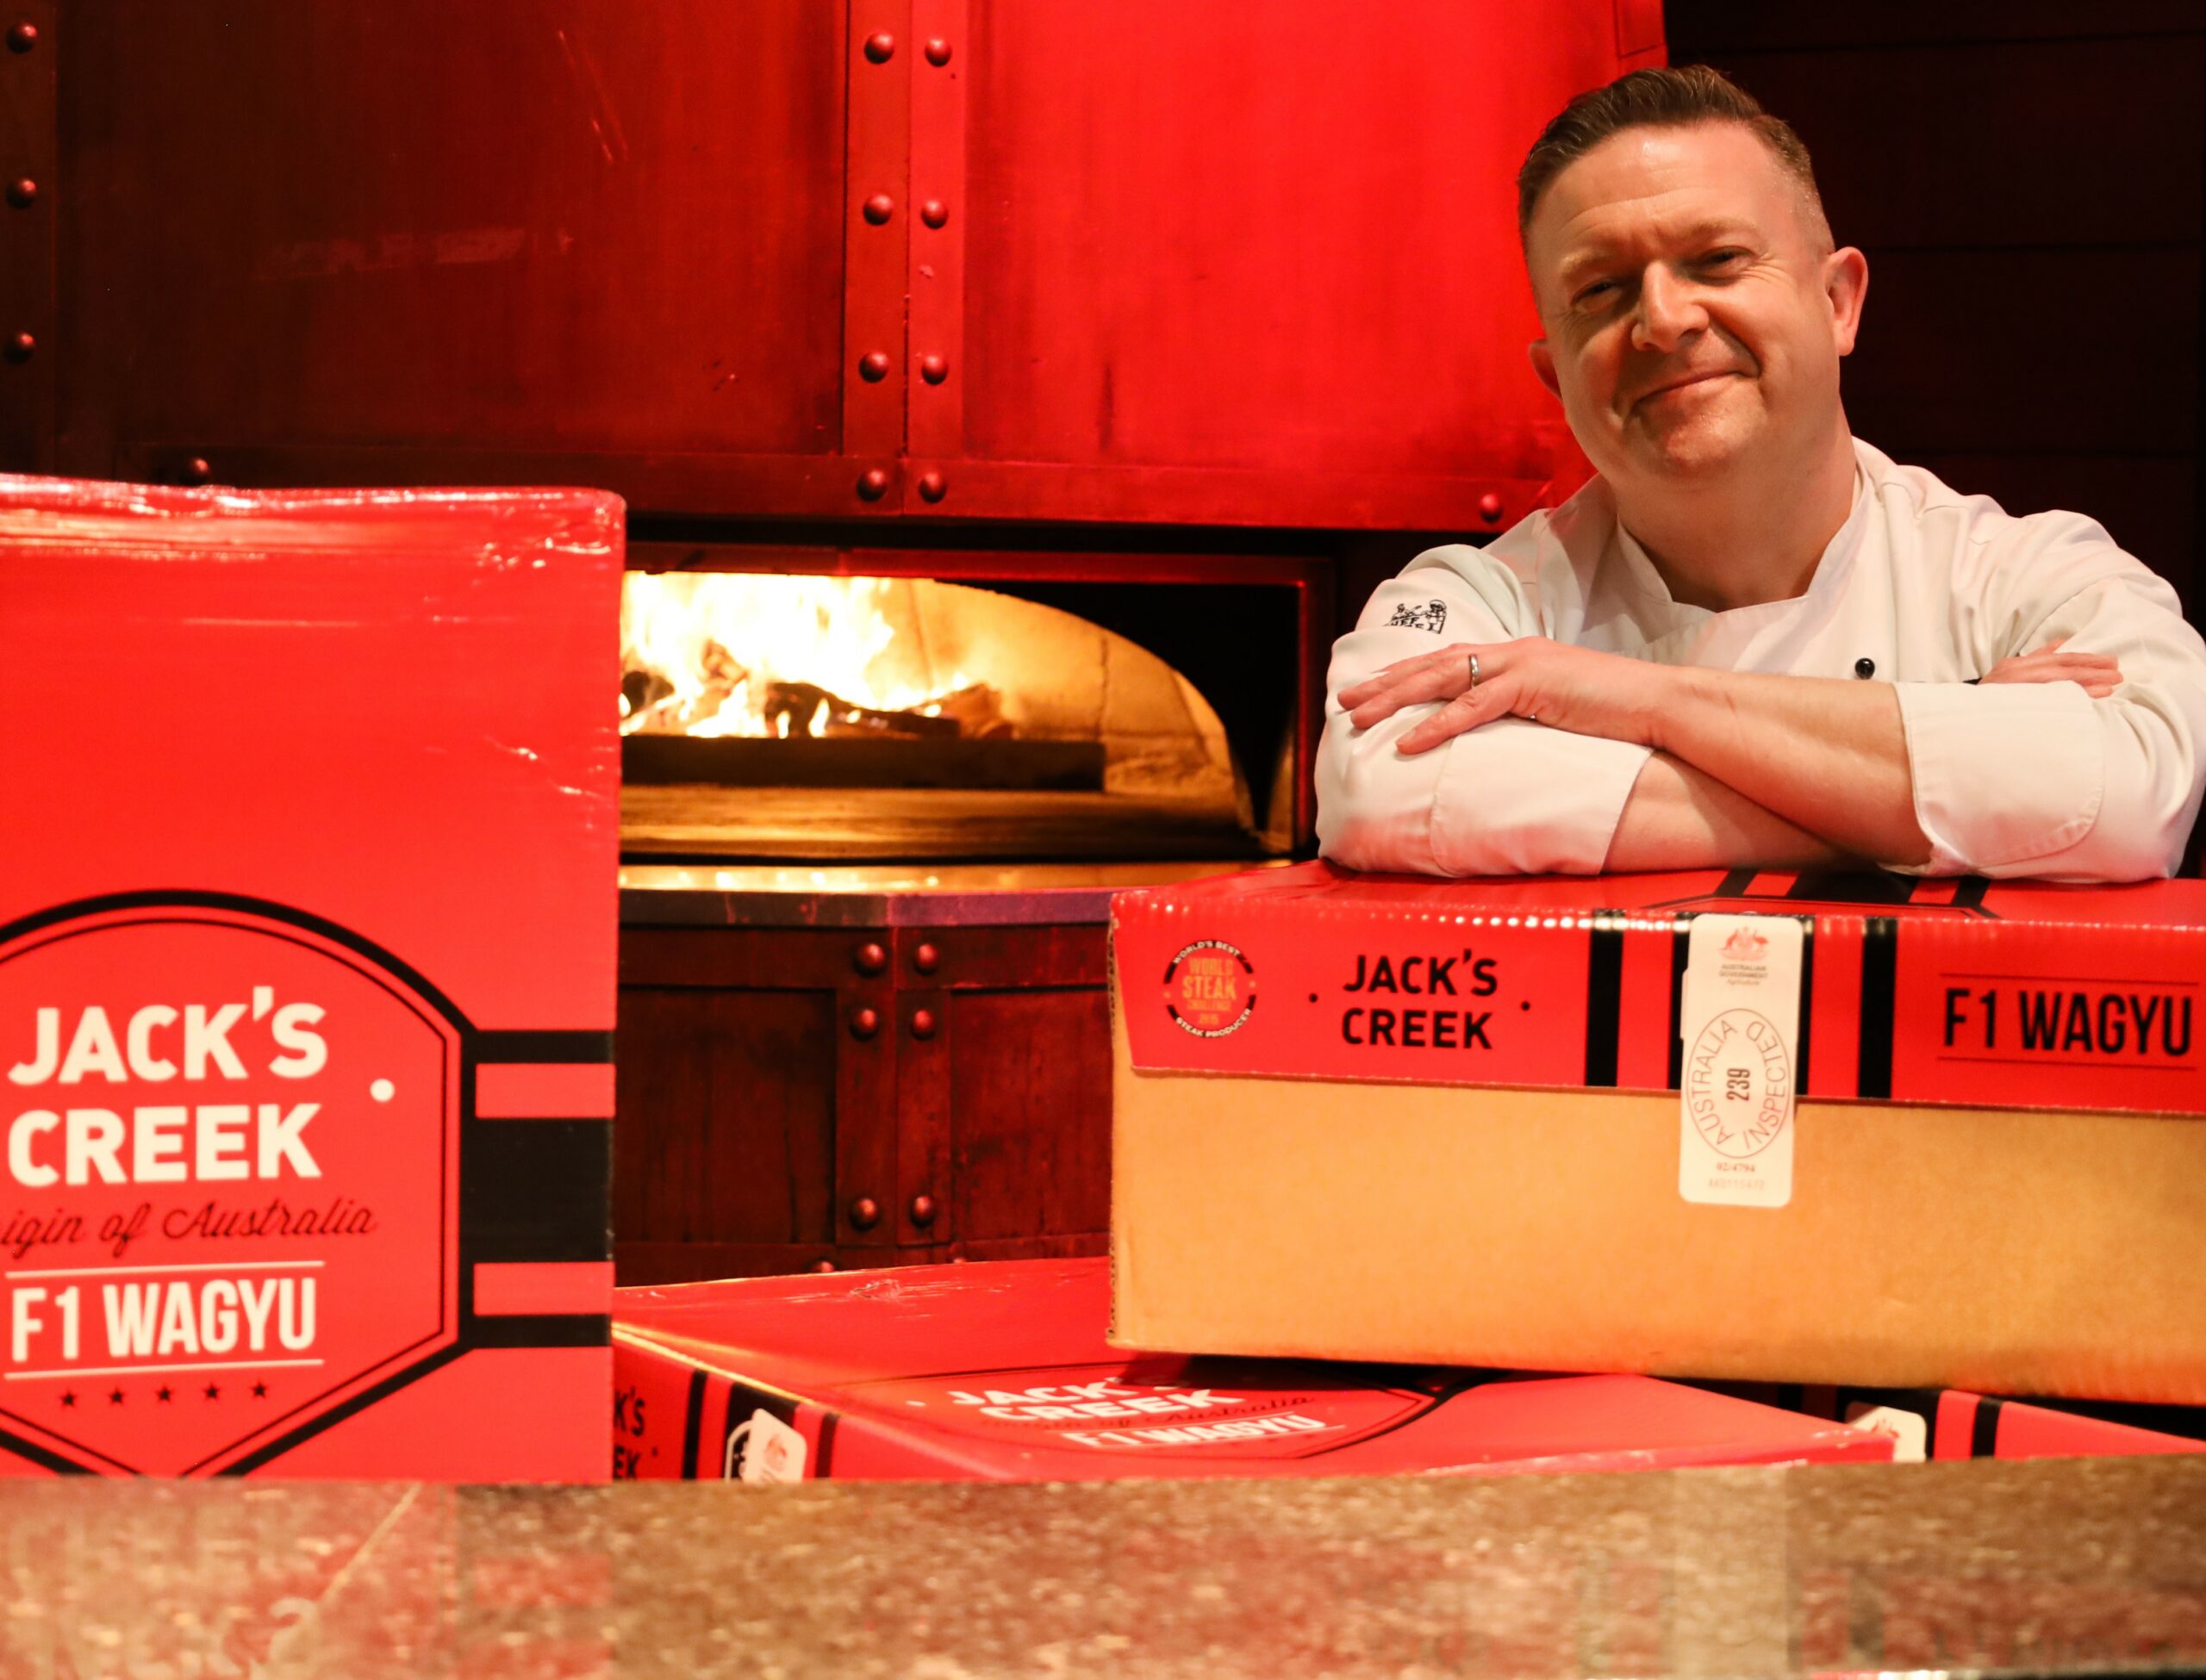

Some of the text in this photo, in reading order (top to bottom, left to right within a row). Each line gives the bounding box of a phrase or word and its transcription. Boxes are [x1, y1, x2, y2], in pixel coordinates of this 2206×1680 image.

[1189, 957, 1234, 975] WORLD
[1215, 941, 1241, 956] BEST
[1181, 975, 1237, 999] STEAK
[1343, 949, 1499, 997] JACK'S
[7, 986, 328, 1086] JACK'S
[1176, 1007, 1252, 1037] STEAK PRODUCER
[1342, 1007, 1493, 1050] CREEK
[1944, 987, 2192, 1057] F1 WAGYU
[1691, 1019, 1737, 1145] AUSTRALIA
[1726, 1067, 1751, 1101] 239
[1742, 1020, 1786, 1149] INSPECTED
[7, 1103, 322, 1187] CREEK
[97, 1202, 152, 1258] of
[162, 1198, 377, 1239] Australia
[11, 1277, 317, 1362] F1 WAGYU
[979, 1389, 1245, 1421] CREEK
[1060, 1414, 1327, 1447] F1 WAGYU
